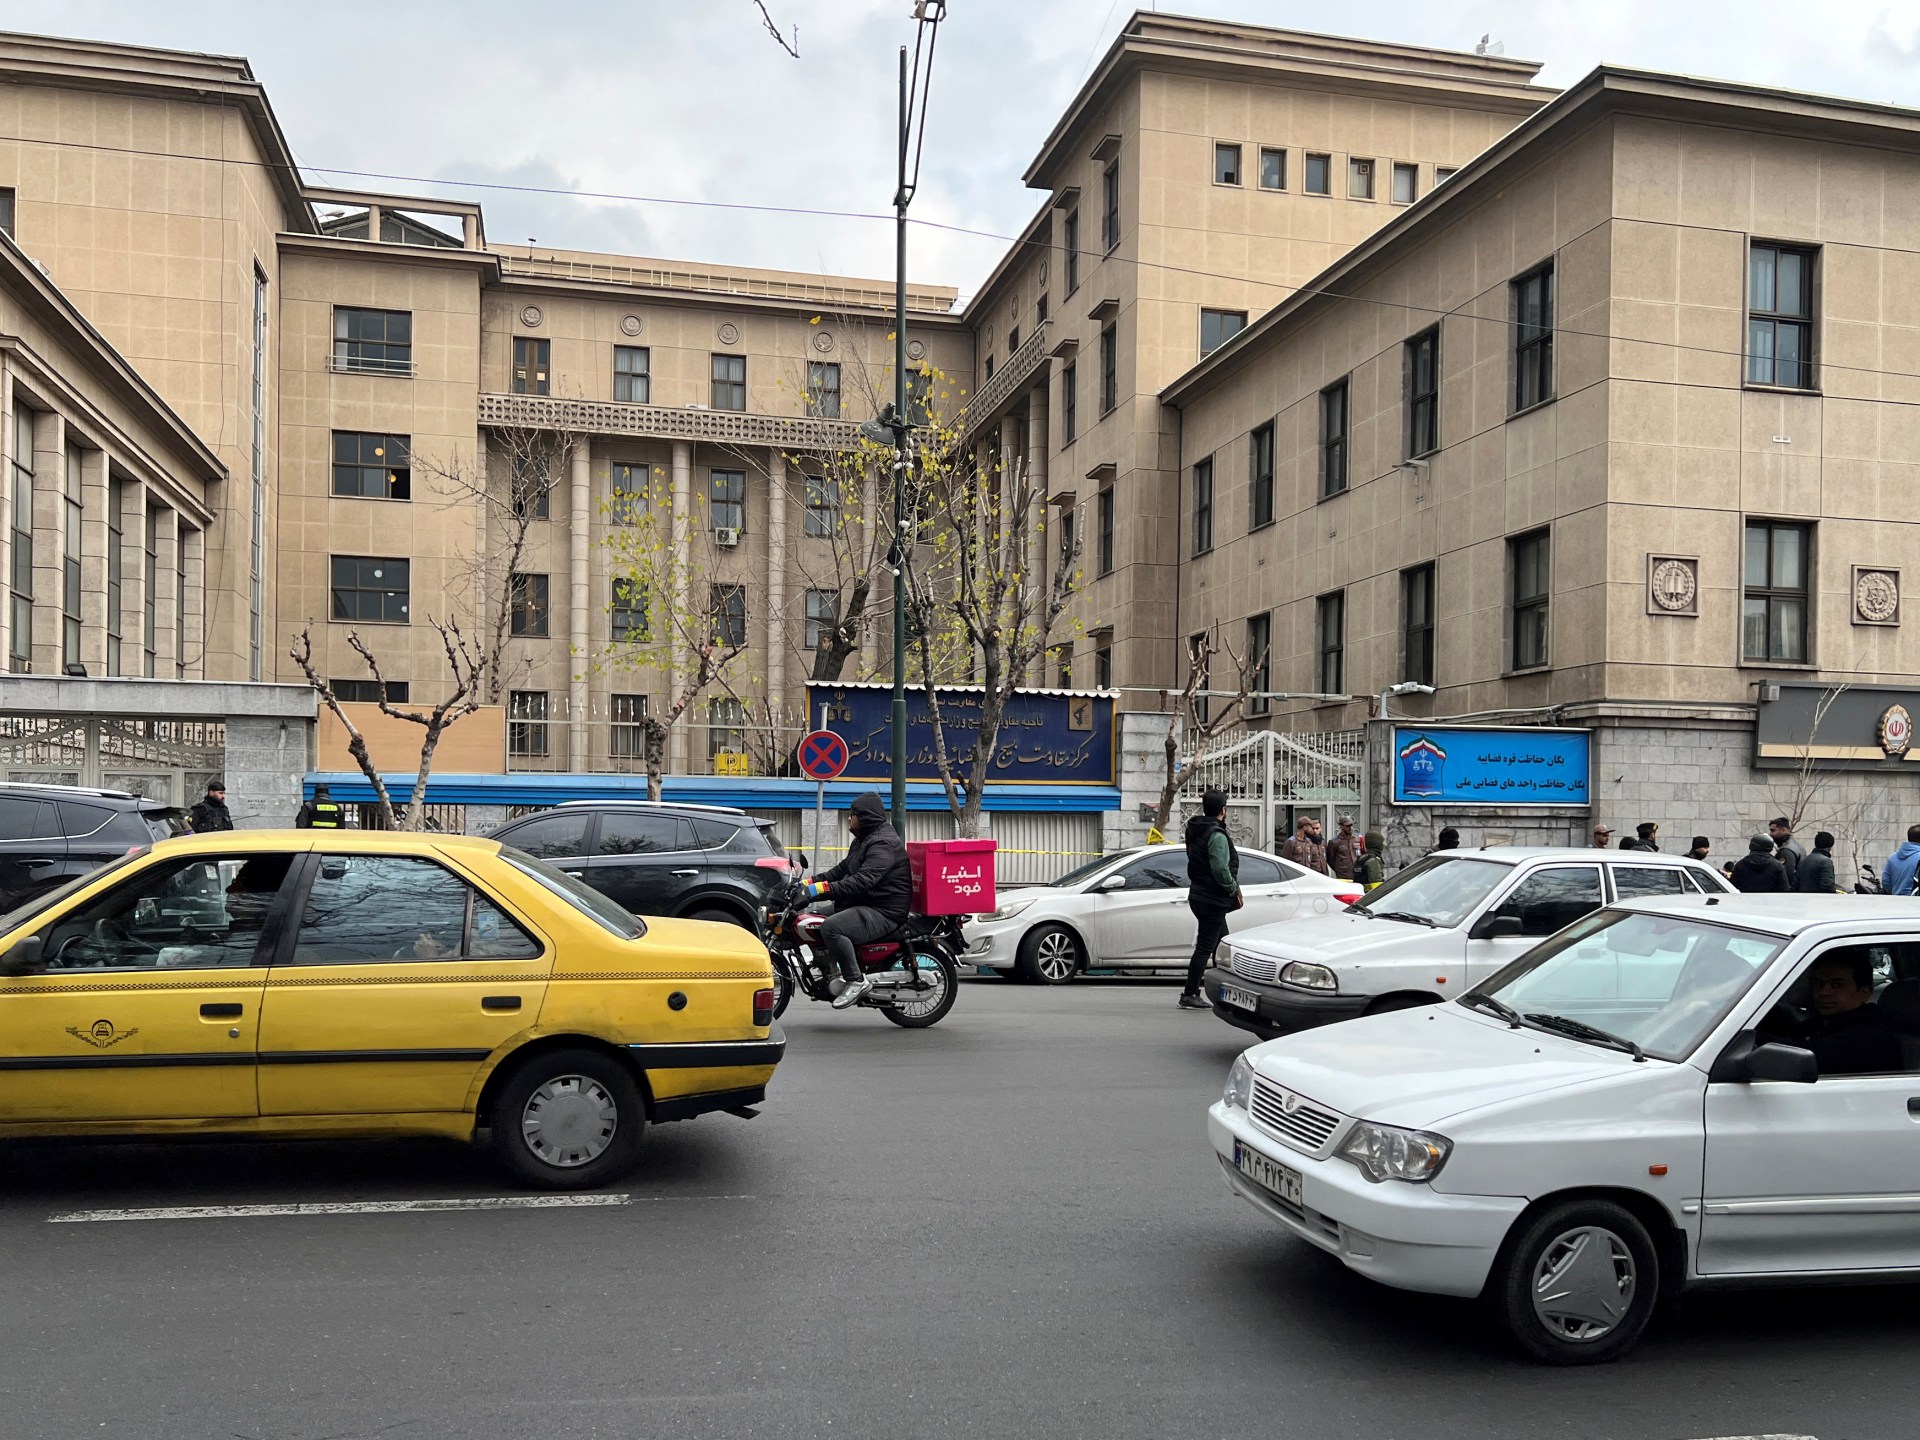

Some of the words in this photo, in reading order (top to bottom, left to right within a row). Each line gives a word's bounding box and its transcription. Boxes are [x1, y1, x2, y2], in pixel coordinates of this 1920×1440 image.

[1021, 716, 1044, 730] ناحیه
[996, 740, 1018, 769] بسیج
[1066, 731, 1097, 768] مرکز
[1018, 746, 1069, 766] مقاومت
[1503, 753, 1516, 766] قوه
[1518, 754, 1545, 764] حفاظت
[1547, 755, 1565, 766] یگان
[1456, 777, 1472, 789] ملی
[1473, 777, 1498, 789] قضایی
[1500, 778, 1515, 790] های
[1517, 778, 1537, 790] واحد
[1538, 779, 1566, 789] حفاظت
[1568, 780, 1585, 791] یگان
[954, 881, 982, 896] فود
